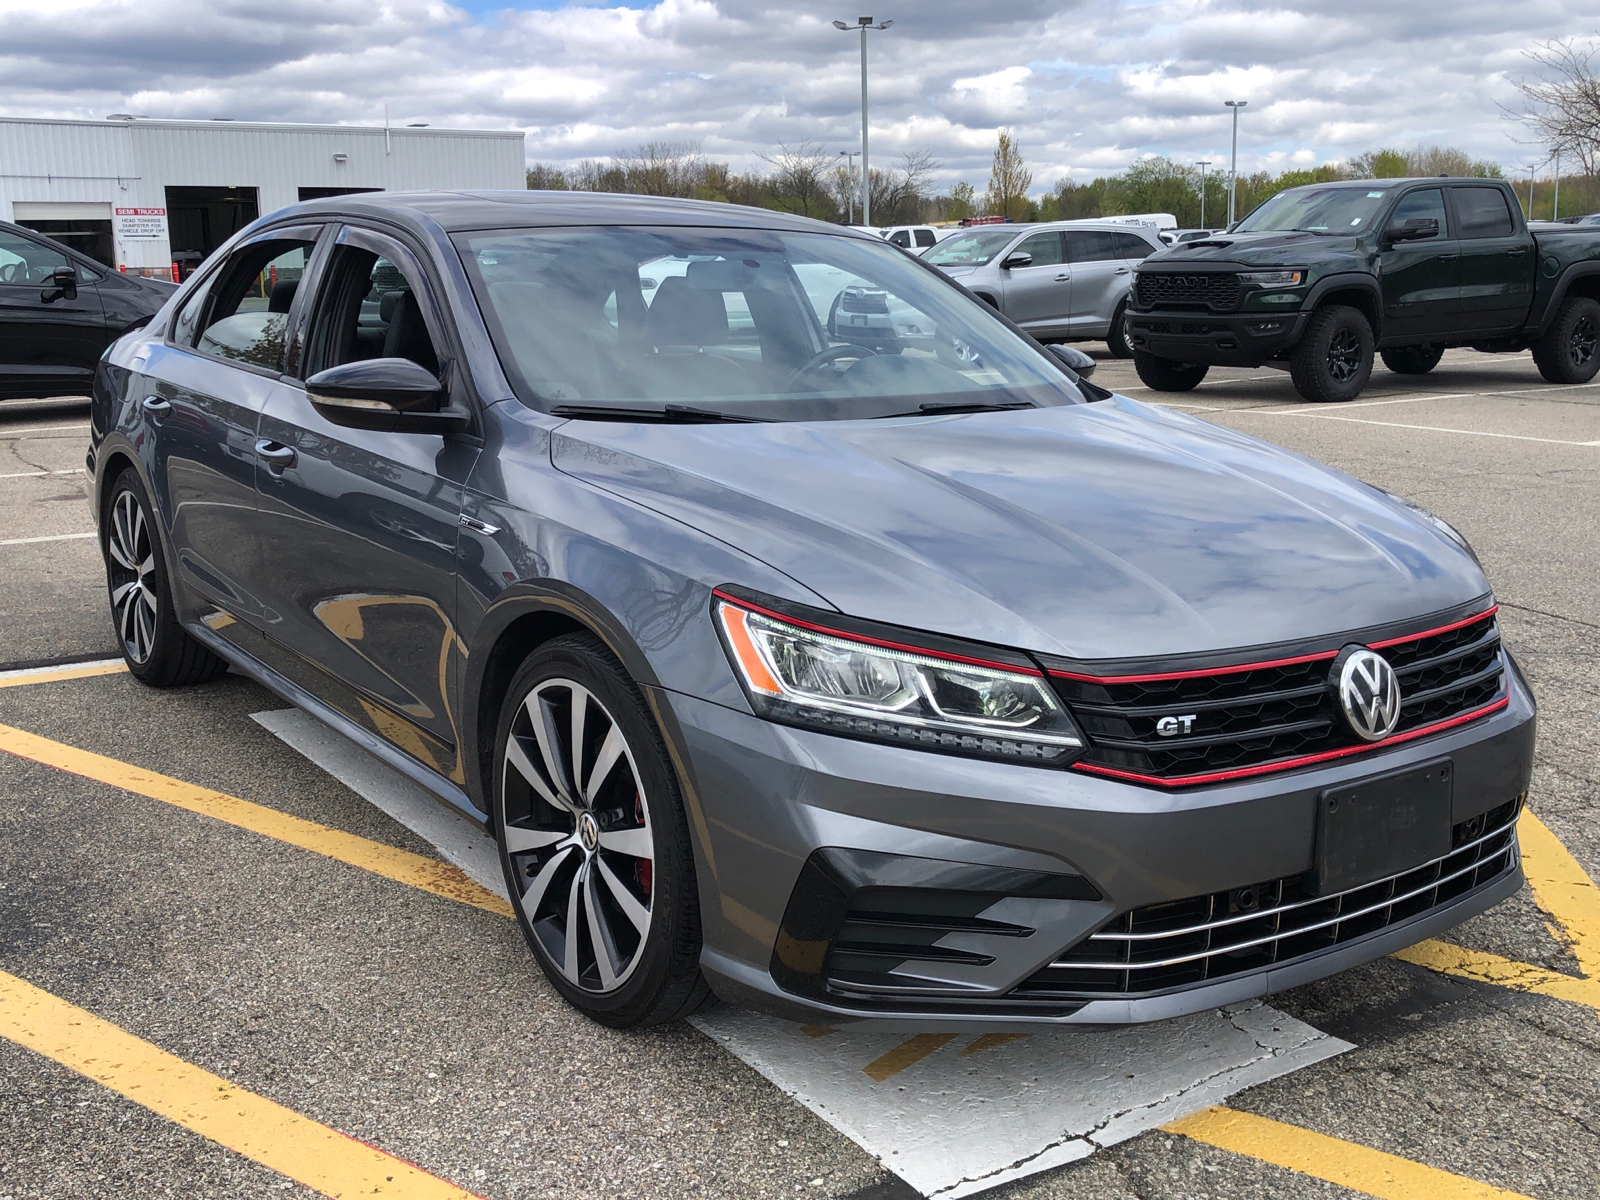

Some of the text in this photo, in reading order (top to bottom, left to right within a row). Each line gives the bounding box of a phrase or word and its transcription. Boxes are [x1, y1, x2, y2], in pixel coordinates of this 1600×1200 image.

[1155, 276, 1209, 287] RAM
[1341, 651, 1401, 741] VW
[1156, 714, 1197, 737] GT
